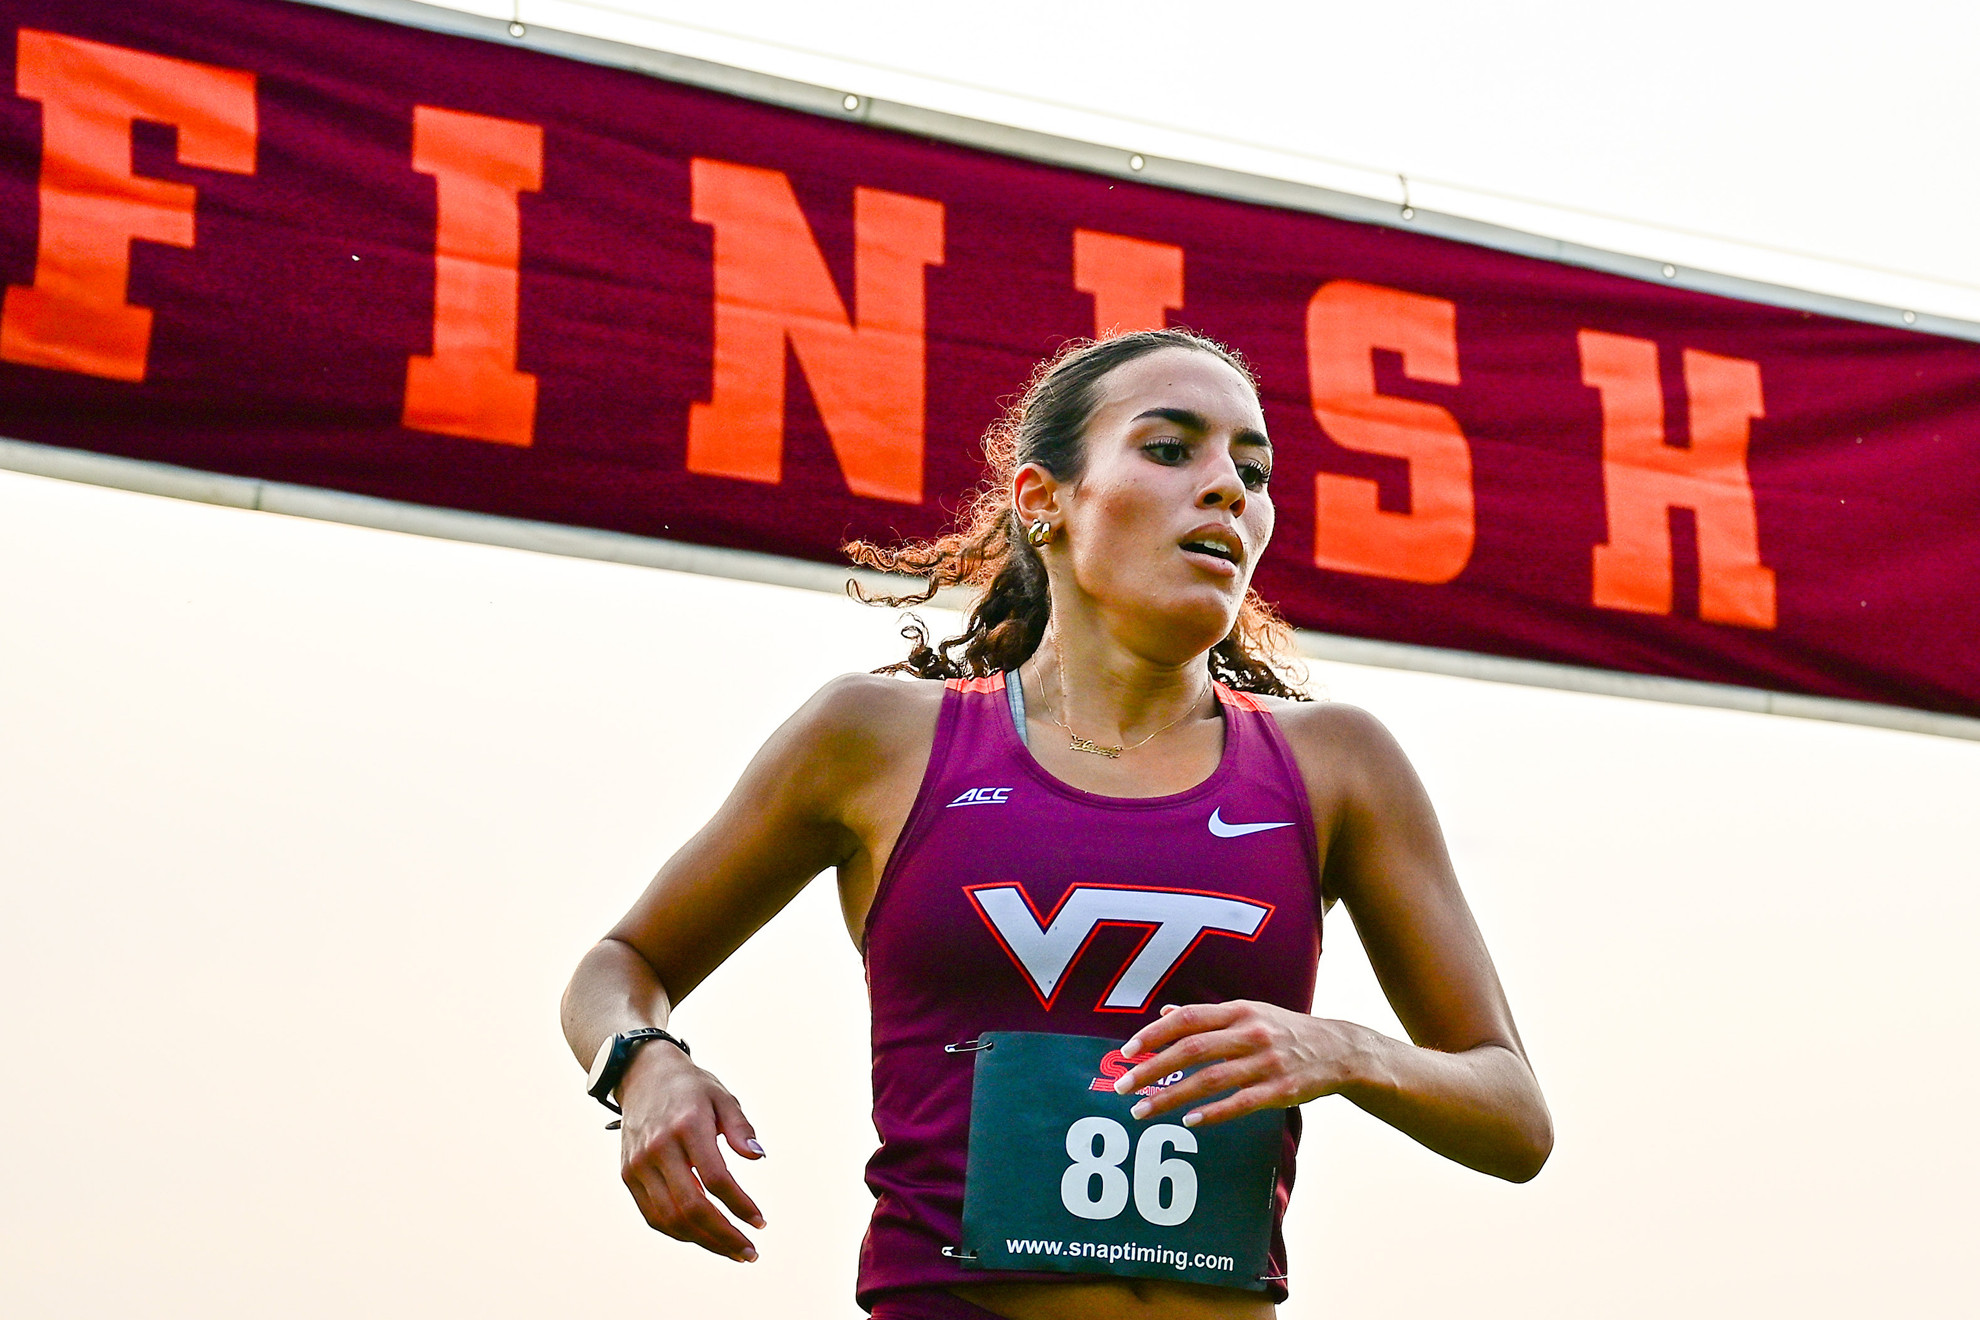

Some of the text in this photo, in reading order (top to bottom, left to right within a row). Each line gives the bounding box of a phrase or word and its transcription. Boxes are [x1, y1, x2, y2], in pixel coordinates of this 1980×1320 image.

[951, 787, 1013, 803] ACC
[962, 881, 1275, 1013] VT
[1061, 1116, 1198, 1226] 86
[1006, 1238, 1235, 1271] www.snaptiming.com
